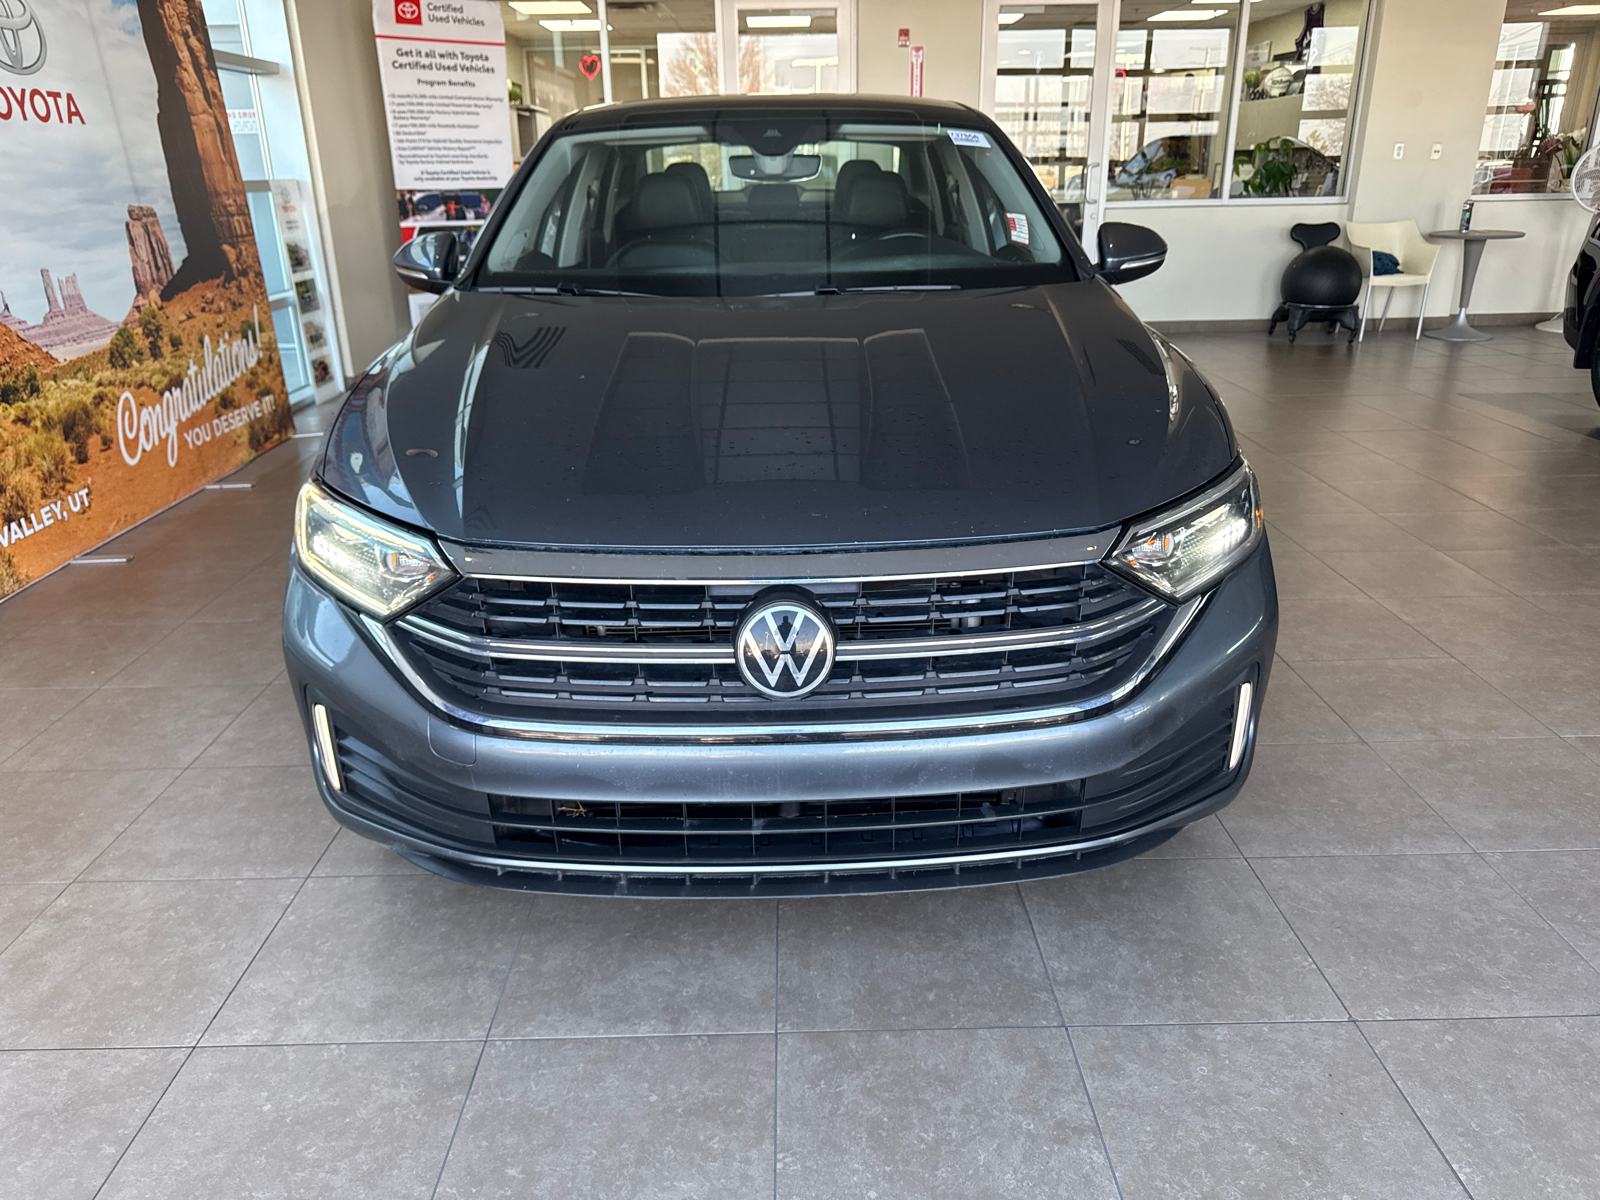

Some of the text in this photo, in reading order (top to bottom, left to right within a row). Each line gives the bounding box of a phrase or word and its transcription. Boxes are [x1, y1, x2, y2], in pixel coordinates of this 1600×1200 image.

[427, 2, 464, 14] Certified
[428, 13, 486, 27] Used Vehicles
[396, 48, 489, 63] Get it all with Toyota
[391, 60, 495, 74] Certified Used Vehicles
[417, 78, 476, 88] Program Benefits
[117, 303, 264, 467] Congratulations!
[183, 422, 212, 450] YOU
[212, 400, 262, 437] DESERVE
[67, 487, 90, 513] UT
